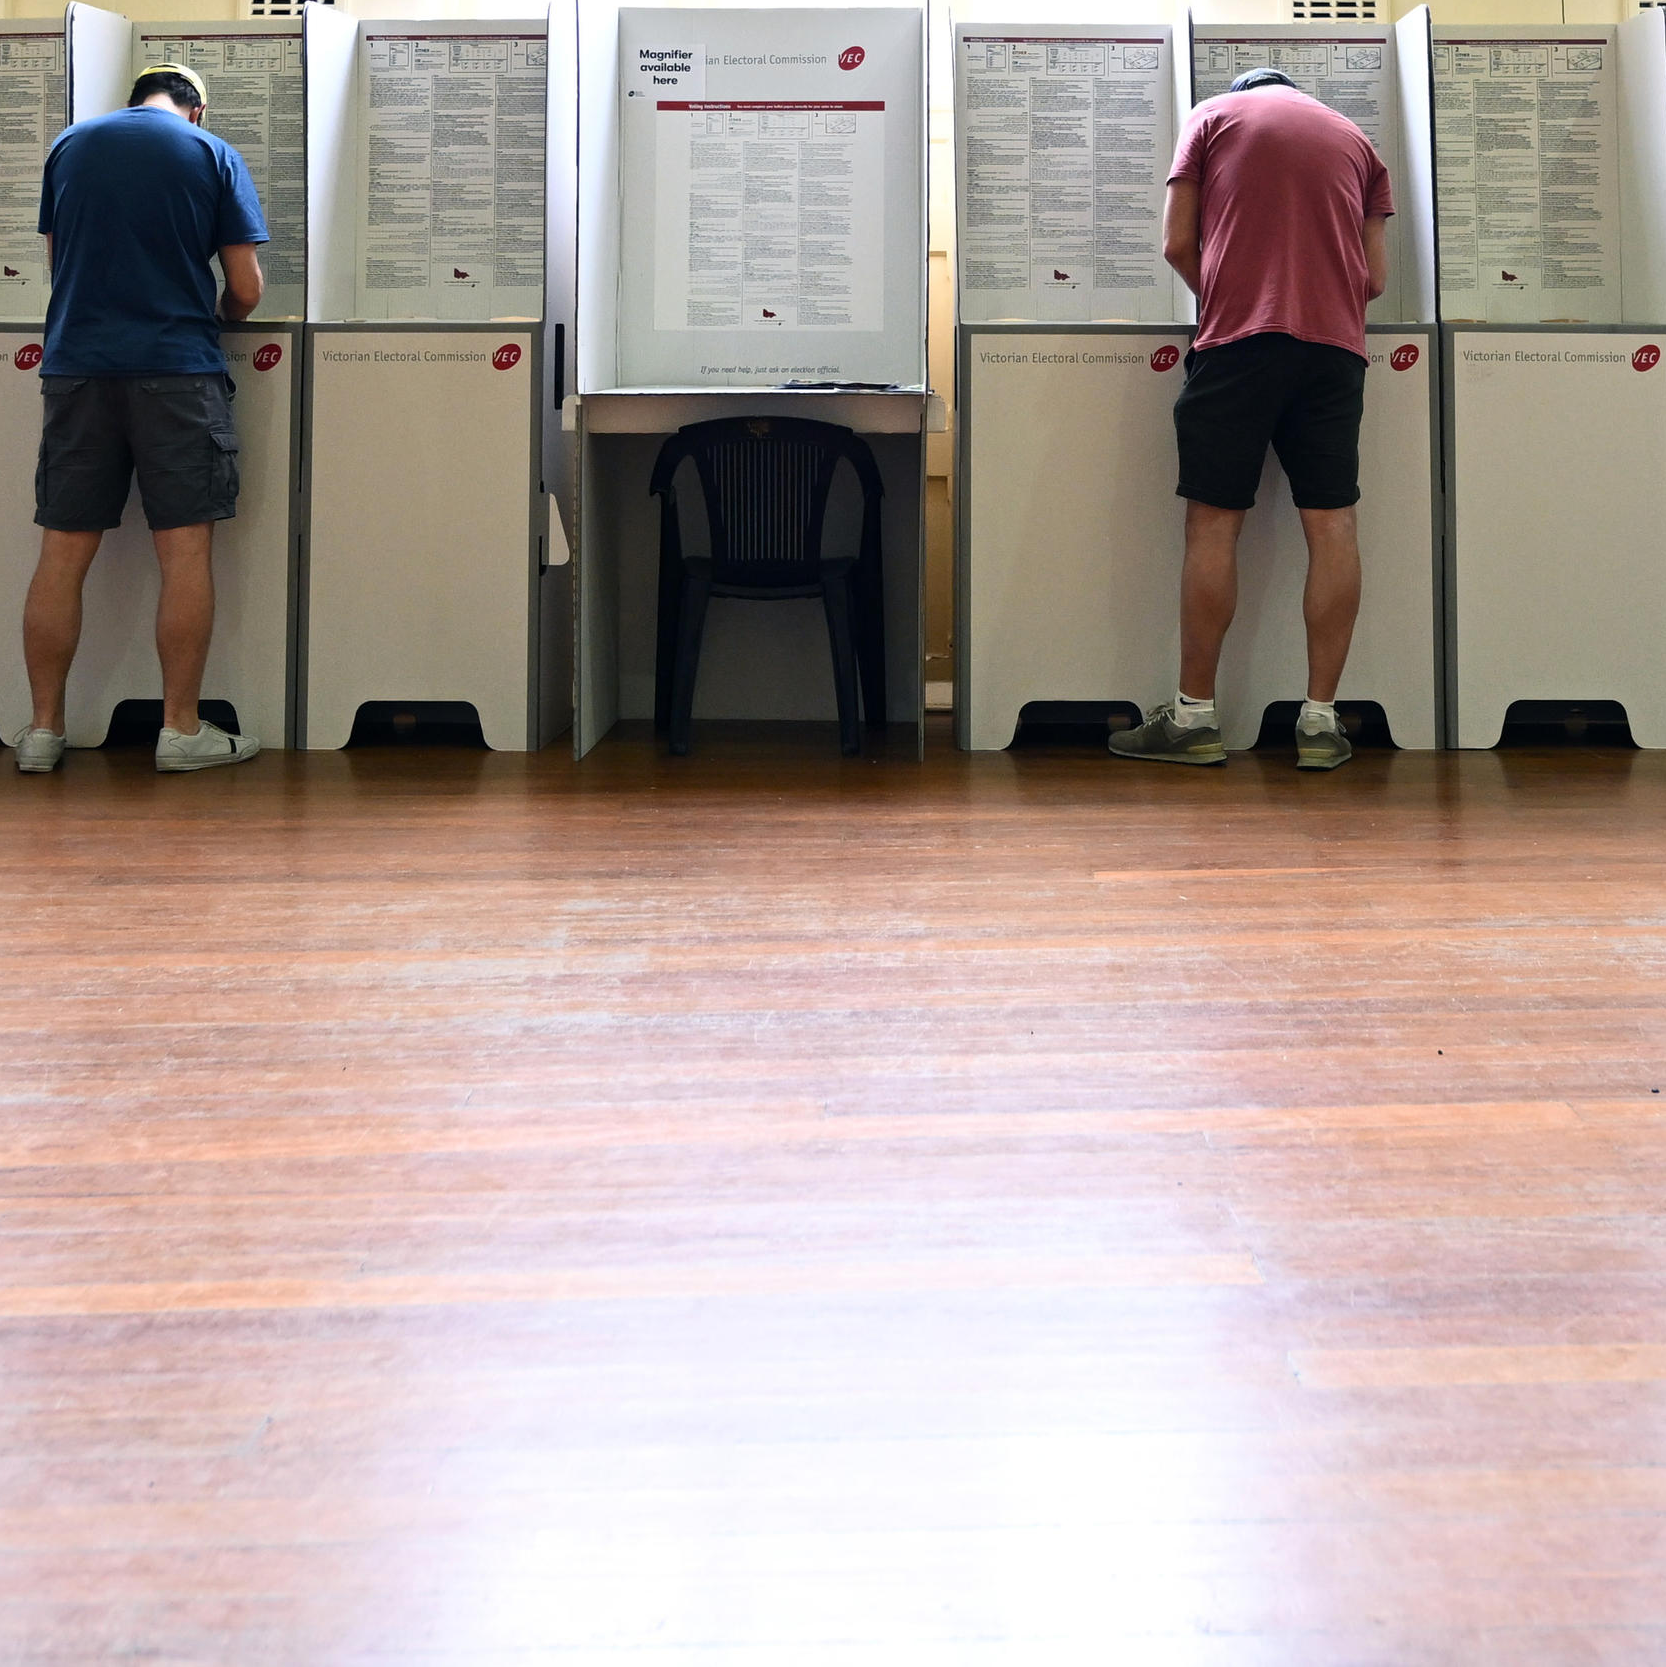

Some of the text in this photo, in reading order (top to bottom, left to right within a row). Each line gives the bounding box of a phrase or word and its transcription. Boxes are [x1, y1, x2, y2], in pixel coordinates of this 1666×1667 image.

[639, 50, 693, 61] Magnifier
[723, 54, 767, 65] Electoral
[769, 54, 827, 65] Commission
[640, 63, 691, 72] available
[653, 75, 678, 85] here
[323, 350, 370, 362] Victorian
[374, 351, 420, 362] Electoral
[425, 351, 486, 361] Commission
[980, 352, 1027, 363] Victorian
[1033, 352, 1078, 363] Electoral
[1083, 350, 1146, 365] Commission
[1463, 350, 1510, 363] Victorian
[1515, 351, 1560, 362] Electoral
[1565, 351, 1625, 362] Commission
[701, 366, 707, 374] If
[707, 367, 719, 375] you
[755, 366, 767, 374] just
